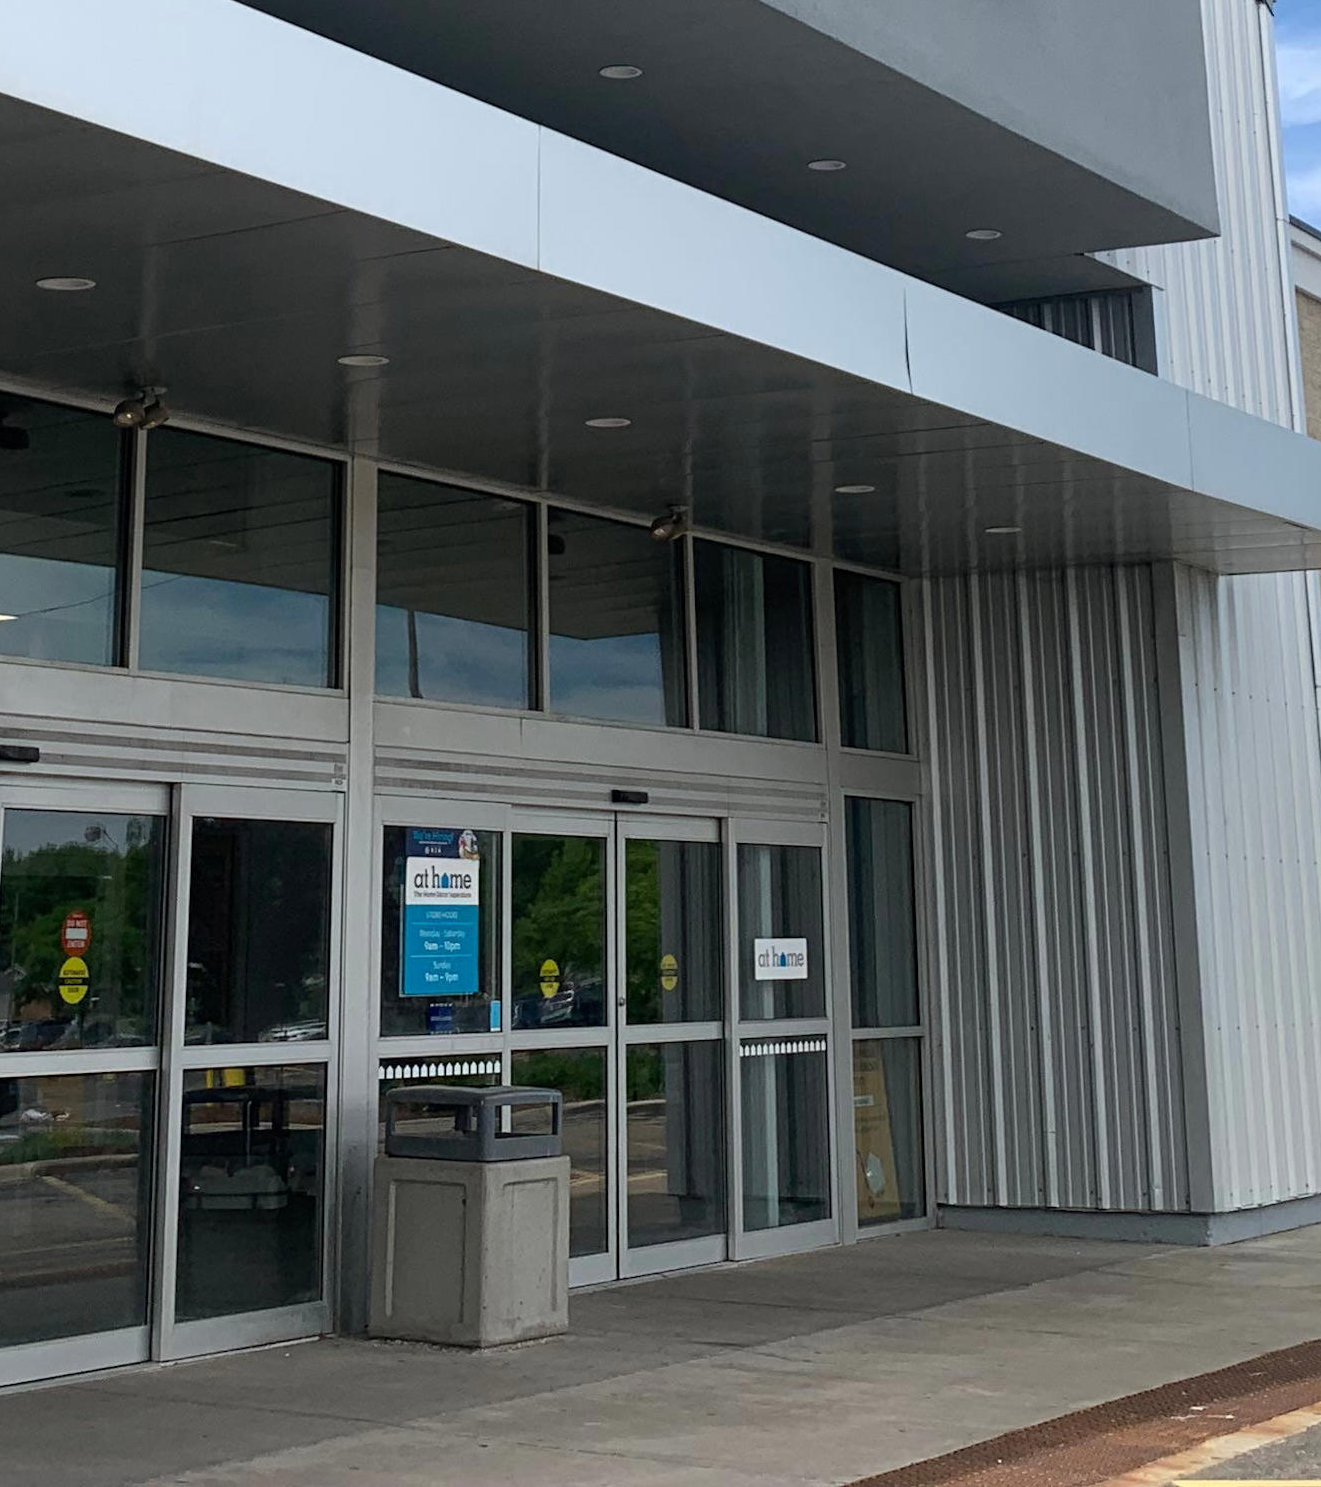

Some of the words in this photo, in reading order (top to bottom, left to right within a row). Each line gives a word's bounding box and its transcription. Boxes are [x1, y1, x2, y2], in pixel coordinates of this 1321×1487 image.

[414, 868, 429, 889] at
[424, 941, 438, 951] 9am
[758, 948, 770, 967] at
